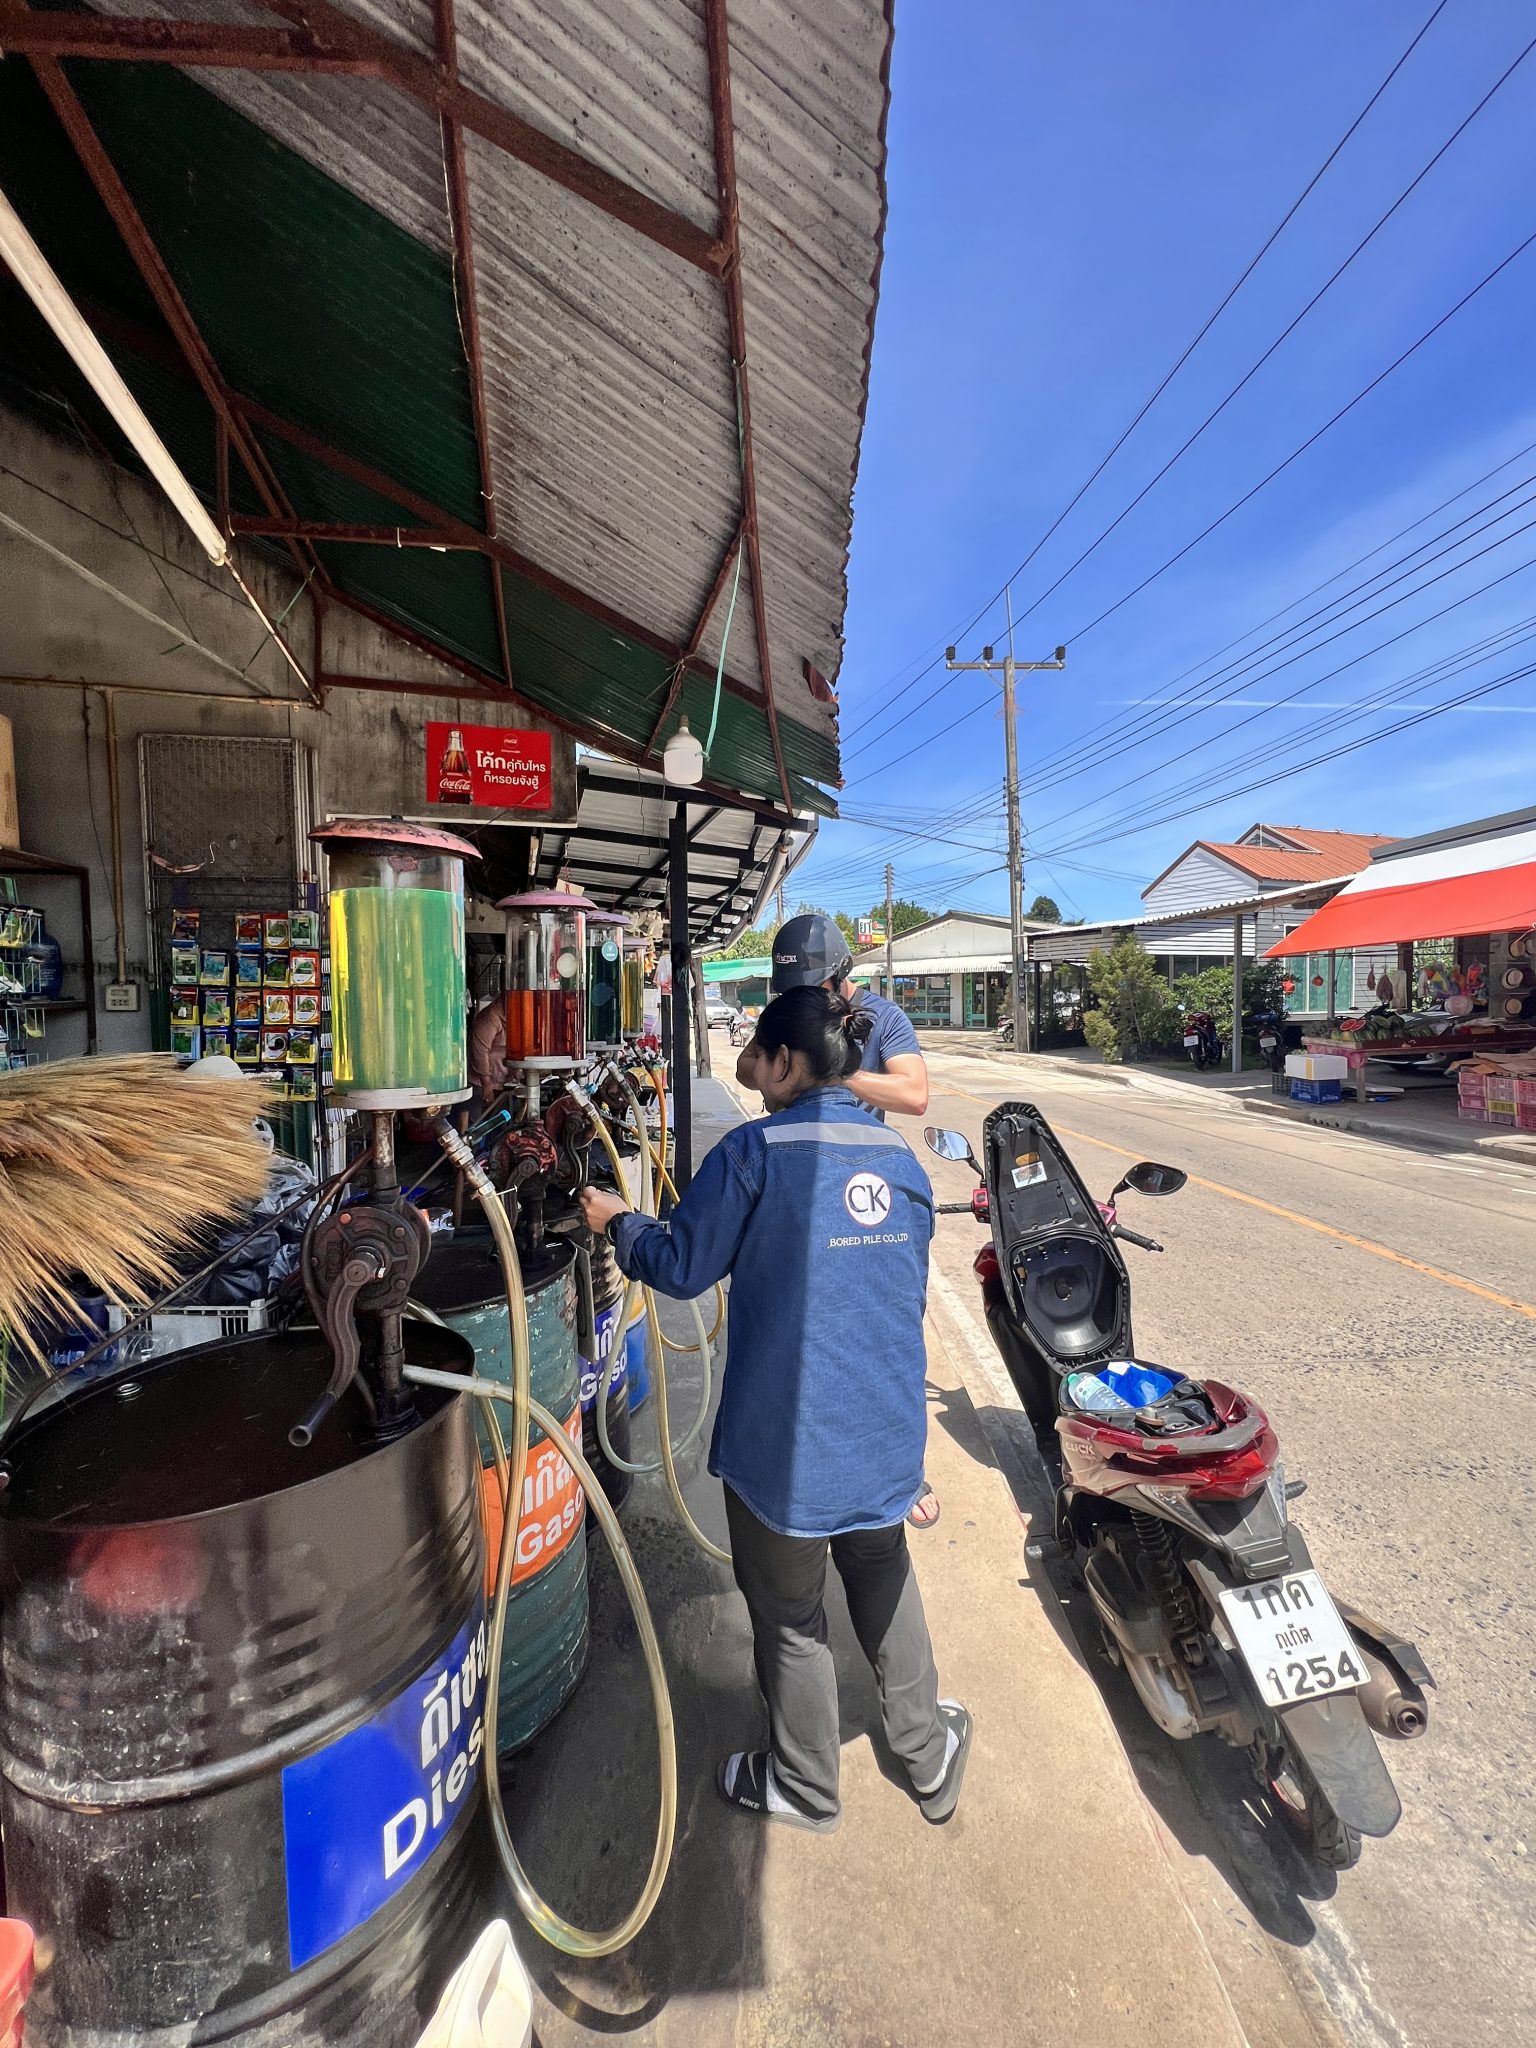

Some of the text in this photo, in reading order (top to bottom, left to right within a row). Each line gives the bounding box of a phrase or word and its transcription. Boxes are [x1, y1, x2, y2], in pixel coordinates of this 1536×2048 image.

[847, 1184, 888, 1213] CK
[829, 1236, 861, 1248] BORED
[863, 1235, 882, 1245] PILE
[1275, 1621, 1313, 1656] ภูเก็ต
[1266, 1650, 1360, 1700] 1254
[739, 1796, 760, 1810] NIKE
